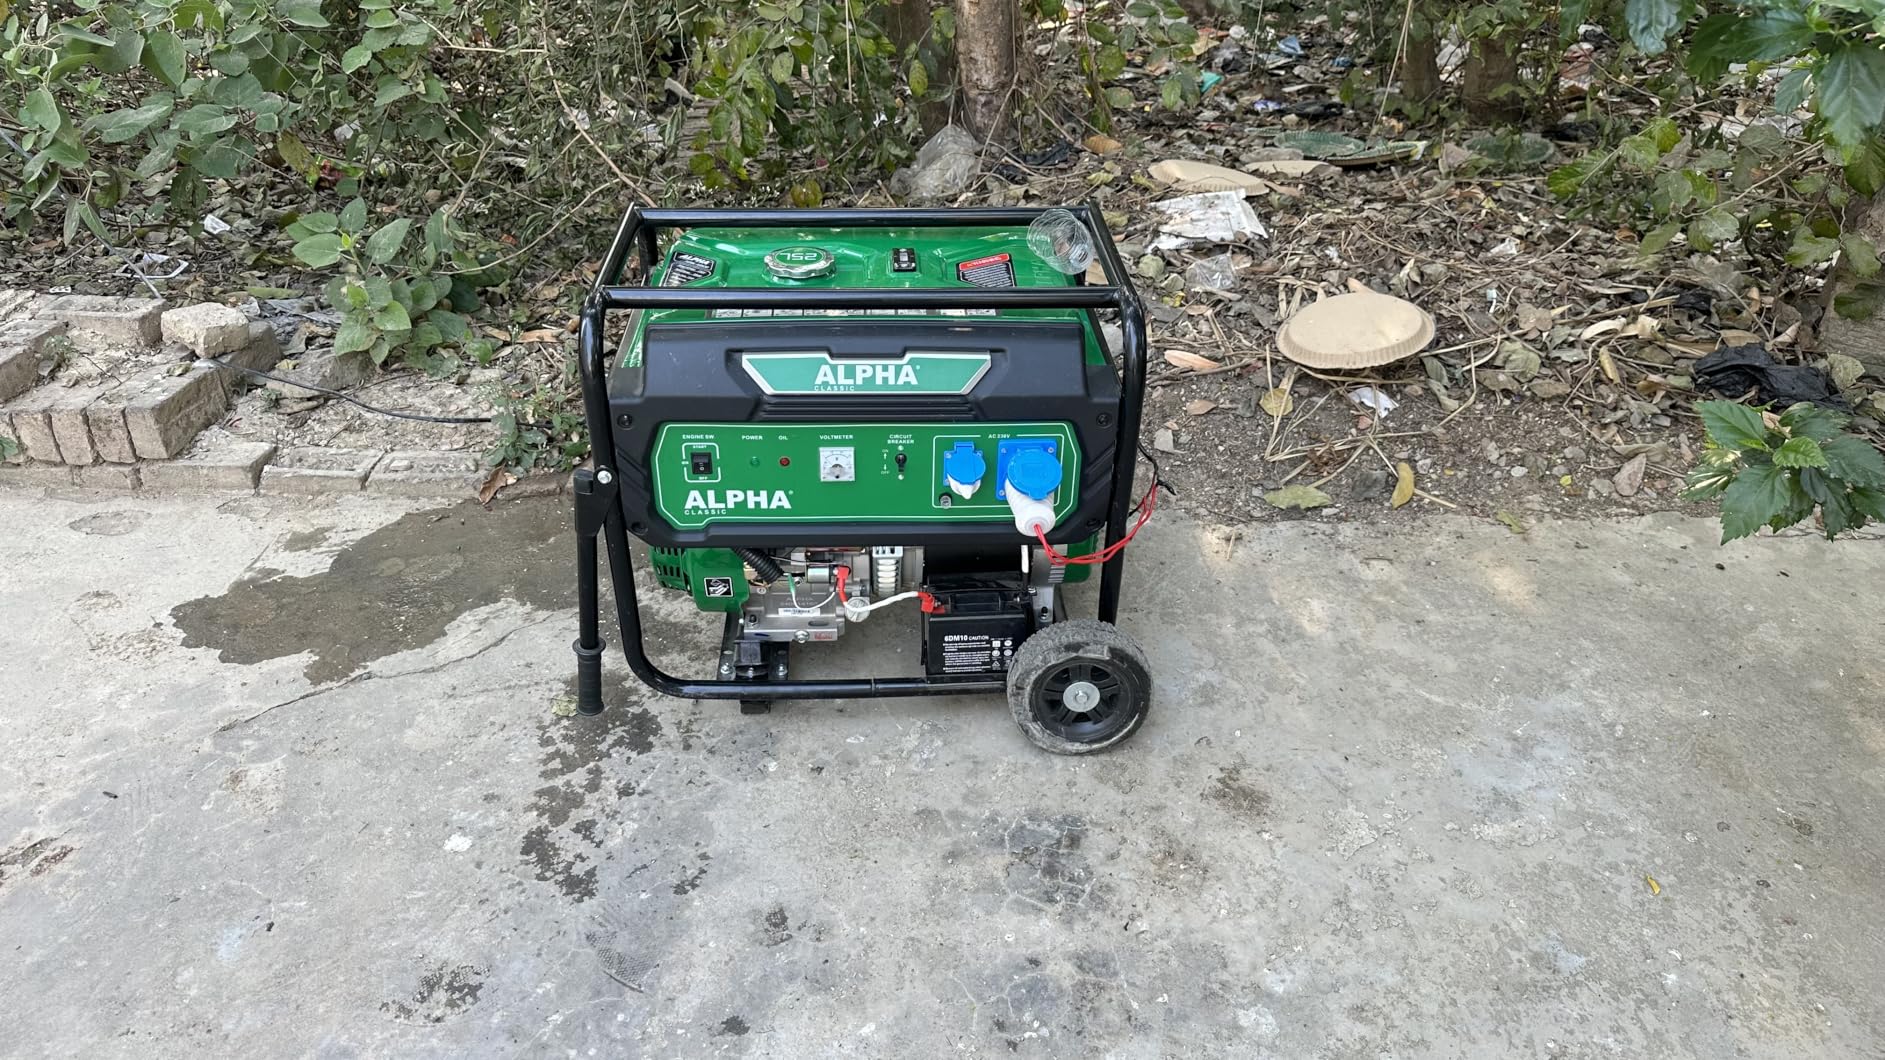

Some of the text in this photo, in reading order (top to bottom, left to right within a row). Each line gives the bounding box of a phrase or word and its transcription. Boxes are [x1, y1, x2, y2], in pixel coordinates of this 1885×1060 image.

[779, 252, 818, 261] 25L
[814, 364, 918, 385] ALPHA
[684, 489, 792, 509] ALPHA
